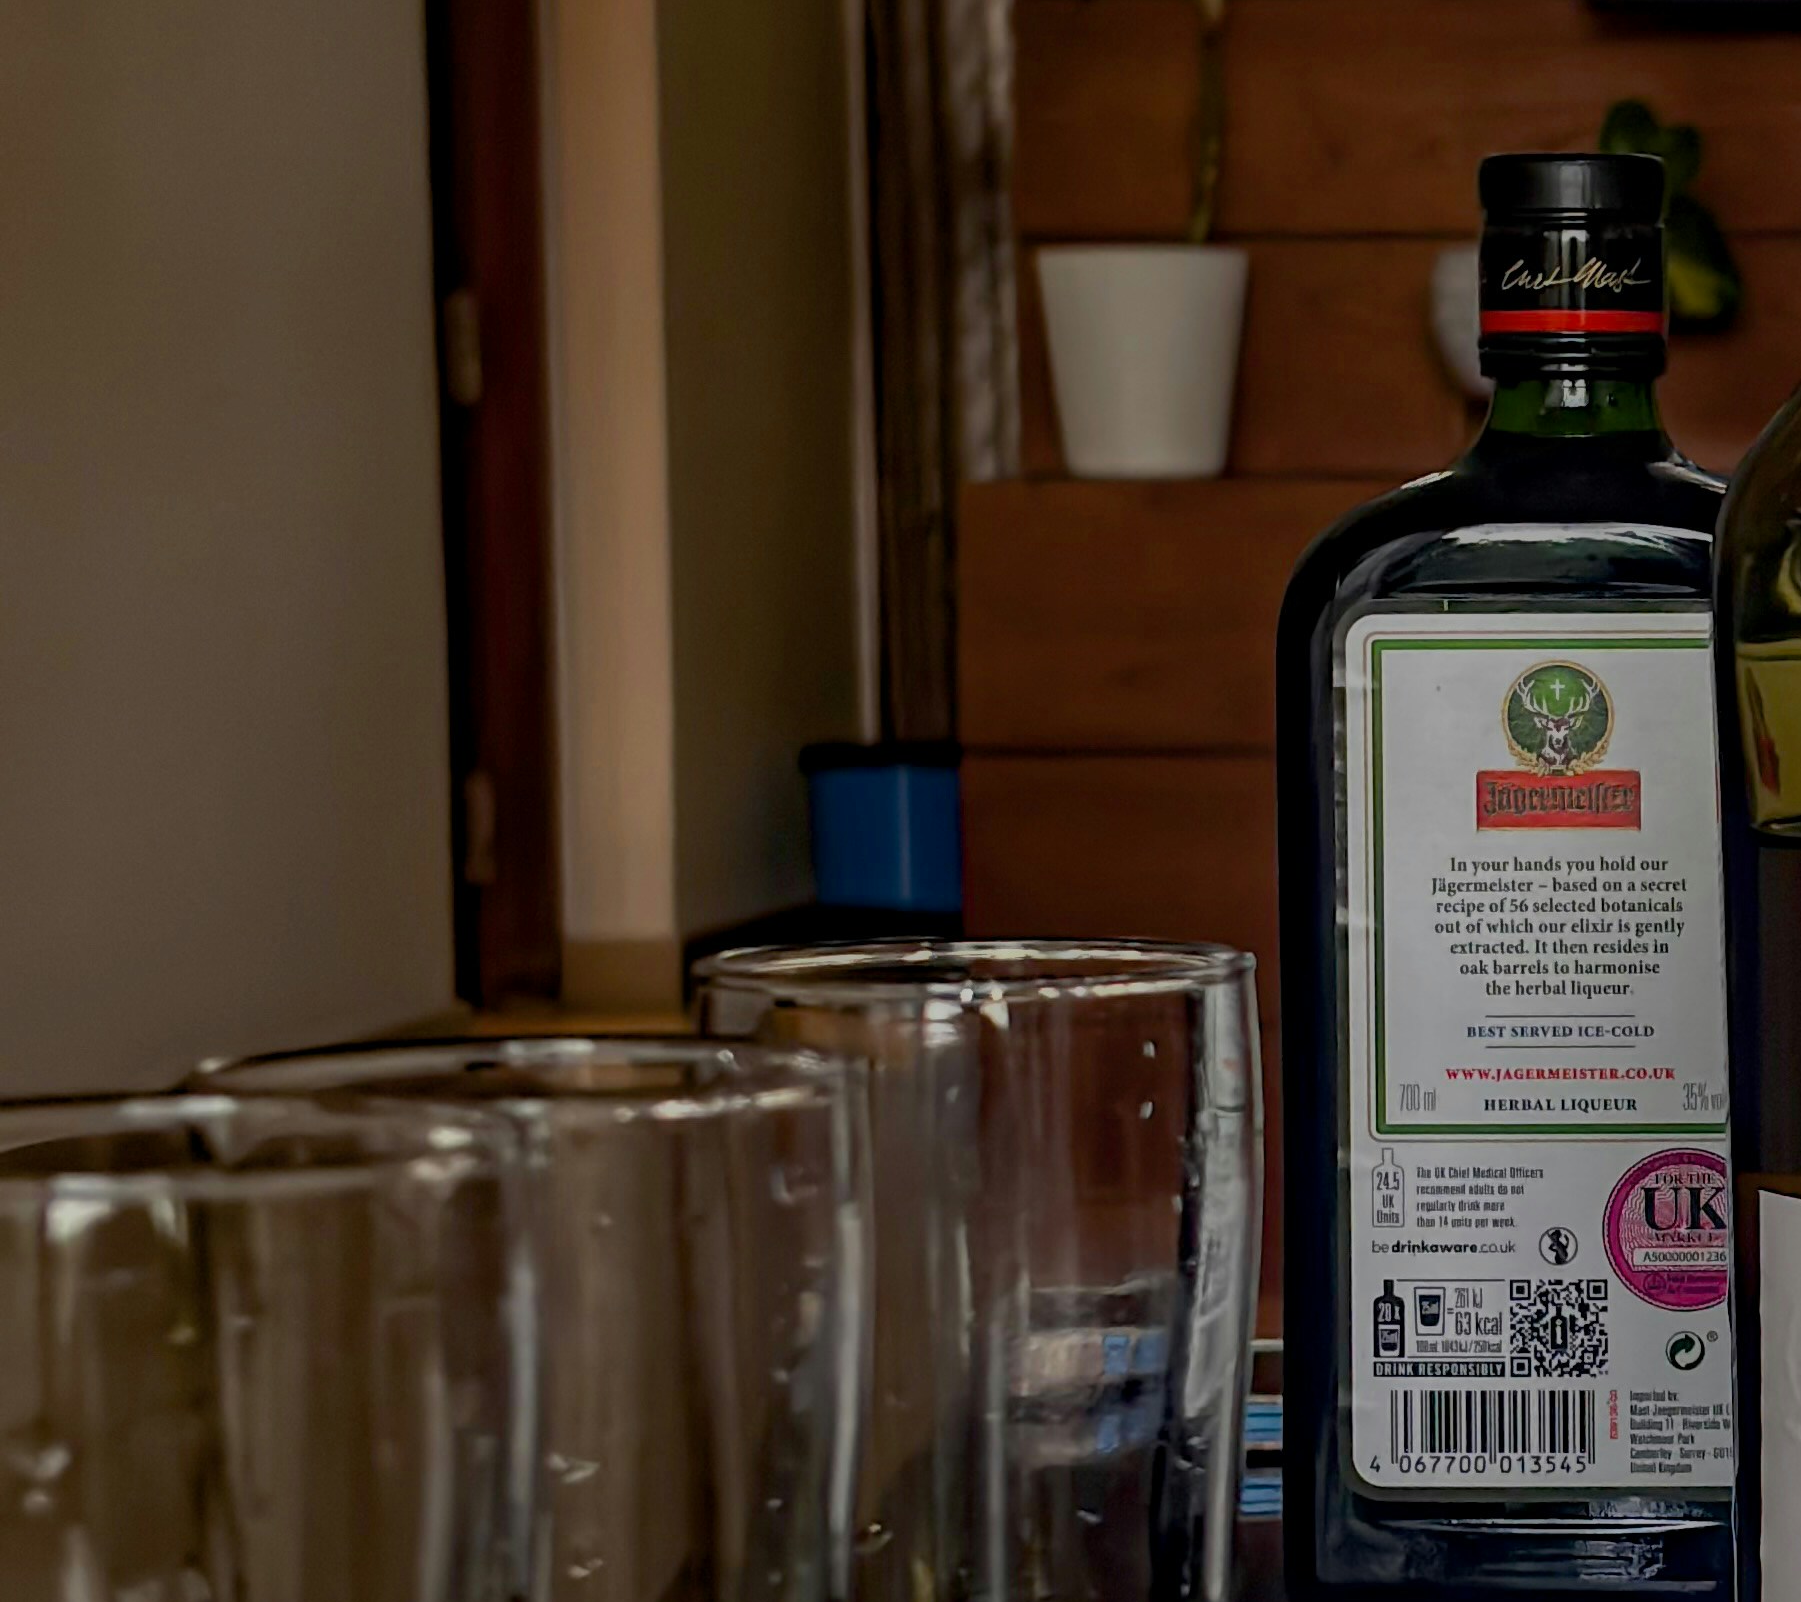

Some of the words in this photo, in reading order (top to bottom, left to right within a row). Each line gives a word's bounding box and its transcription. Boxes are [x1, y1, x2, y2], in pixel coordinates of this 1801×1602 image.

[1451, 856, 1468, 871] In
[1472, 859, 1509, 876] your
[1514, 856, 1562, 871] hands
[1567, 859, 1595, 876] you
[1600, 856, 1635, 871] hold
[1640, 859, 1668, 871] our
[1432, 877, 1533, 896] Jägermeister
[1553, 877, 1597, 892] based
[1603, 881, 1622, 892] on
[1627, 881, 1636, 892] a
[1640, 878, 1687, 892] secret
[1436, 898, 1485, 916] recipe
[1489, 897, 1507, 912] of
[1510, 898, 1528, 913] 56
[1533, 897, 1596, 912] selected
[1601, 897, 1683, 912] botanicals
[1434, 920, 1461, 934] out
[1465, 918, 1484, 933] of
[1487, 918, 1534, 933] which
[1538, 921, 1567, 933] our
[1570, 918, 1613, 933] elixir
[1618, 918, 1631, 933] is
[1635, 918, 1685, 937] gently
[1450, 939, 1529, 954] extracted.
[1535, 940, 1548, 954] It
[1552, 939, 1589, 954] then
[1593, 939, 1649, 953] resides
[1653, 939, 1669, 953] in
[1459, 959, 1489, 974] oak
[1493, 959, 1549, 974] barrels
[1554, 962, 1569, 974] to
[1574, 959, 1660, 974] harmonise
[1486, 980, 1511, 995] the
[1515, 980, 1566, 995] herbal
[1571, 980, 1634, 999] liqueur.
[1467, 1026, 1505, 1039] BEST
[1511, 1026, 1573, 1039] SERVED
[1578, 1026, 1655, 1039] ICE-COLD
[1445, 1068, 1675, 1082] WWW.JAGERMEISTER.CO.UK
[1399, 1083, 1420, 1111] 700
[1424, 1086, 1437, 1111] ml
[1682, 1082, 1709, 1111] 35%
[1484, 1098, 1556, 1111] HERBAL
[1561, 1098, 1637, 1113] LIQUEUR
[1416, 1167, 1431, 1178] The
[1449, 1167, 1470, 1178] Chief
[1473, 1167, 1507, 1178] Medical
[1509, 1167, 1544, 1179] Officers
[1376, 1171, 1400, 1191] 24.5
[1416, 1184, 1465, 1195] recommend
[1469, 1184, 1495, 1195] adults
[1497, 1184, 1508, 1195] do
[1511, 1184, 1525, 1195] not
[1382, 1195, 1394, 1209] UK
[1416, 1200, 1455, 1212] regularly
[1458, 1200, 1480, 1211] drink
[1483, 1201, 1505, 1211] more
[1641, 1186, 1727, 1231] UK
[1376, 1210, 1400, 1224] Units
[1416, 1216, 1436, 1227] than
[1439, 1216, 1449, 1227] 14
[1451, 1216, 1472, 1227] units
[1455, 1311, 1471, 1336] 63
[1475, 1311, 1503, 1336] kcal
[1376, 1362, 1413, 1376] DRINK
[1418, 1362, 1503, 1377] RESPONSIBLY
[1370, 1455, 1380, 1473] 4
[1400, 1455, 1486, 1473] 067700
[1500, 1455, 1586, 1473] 013545
